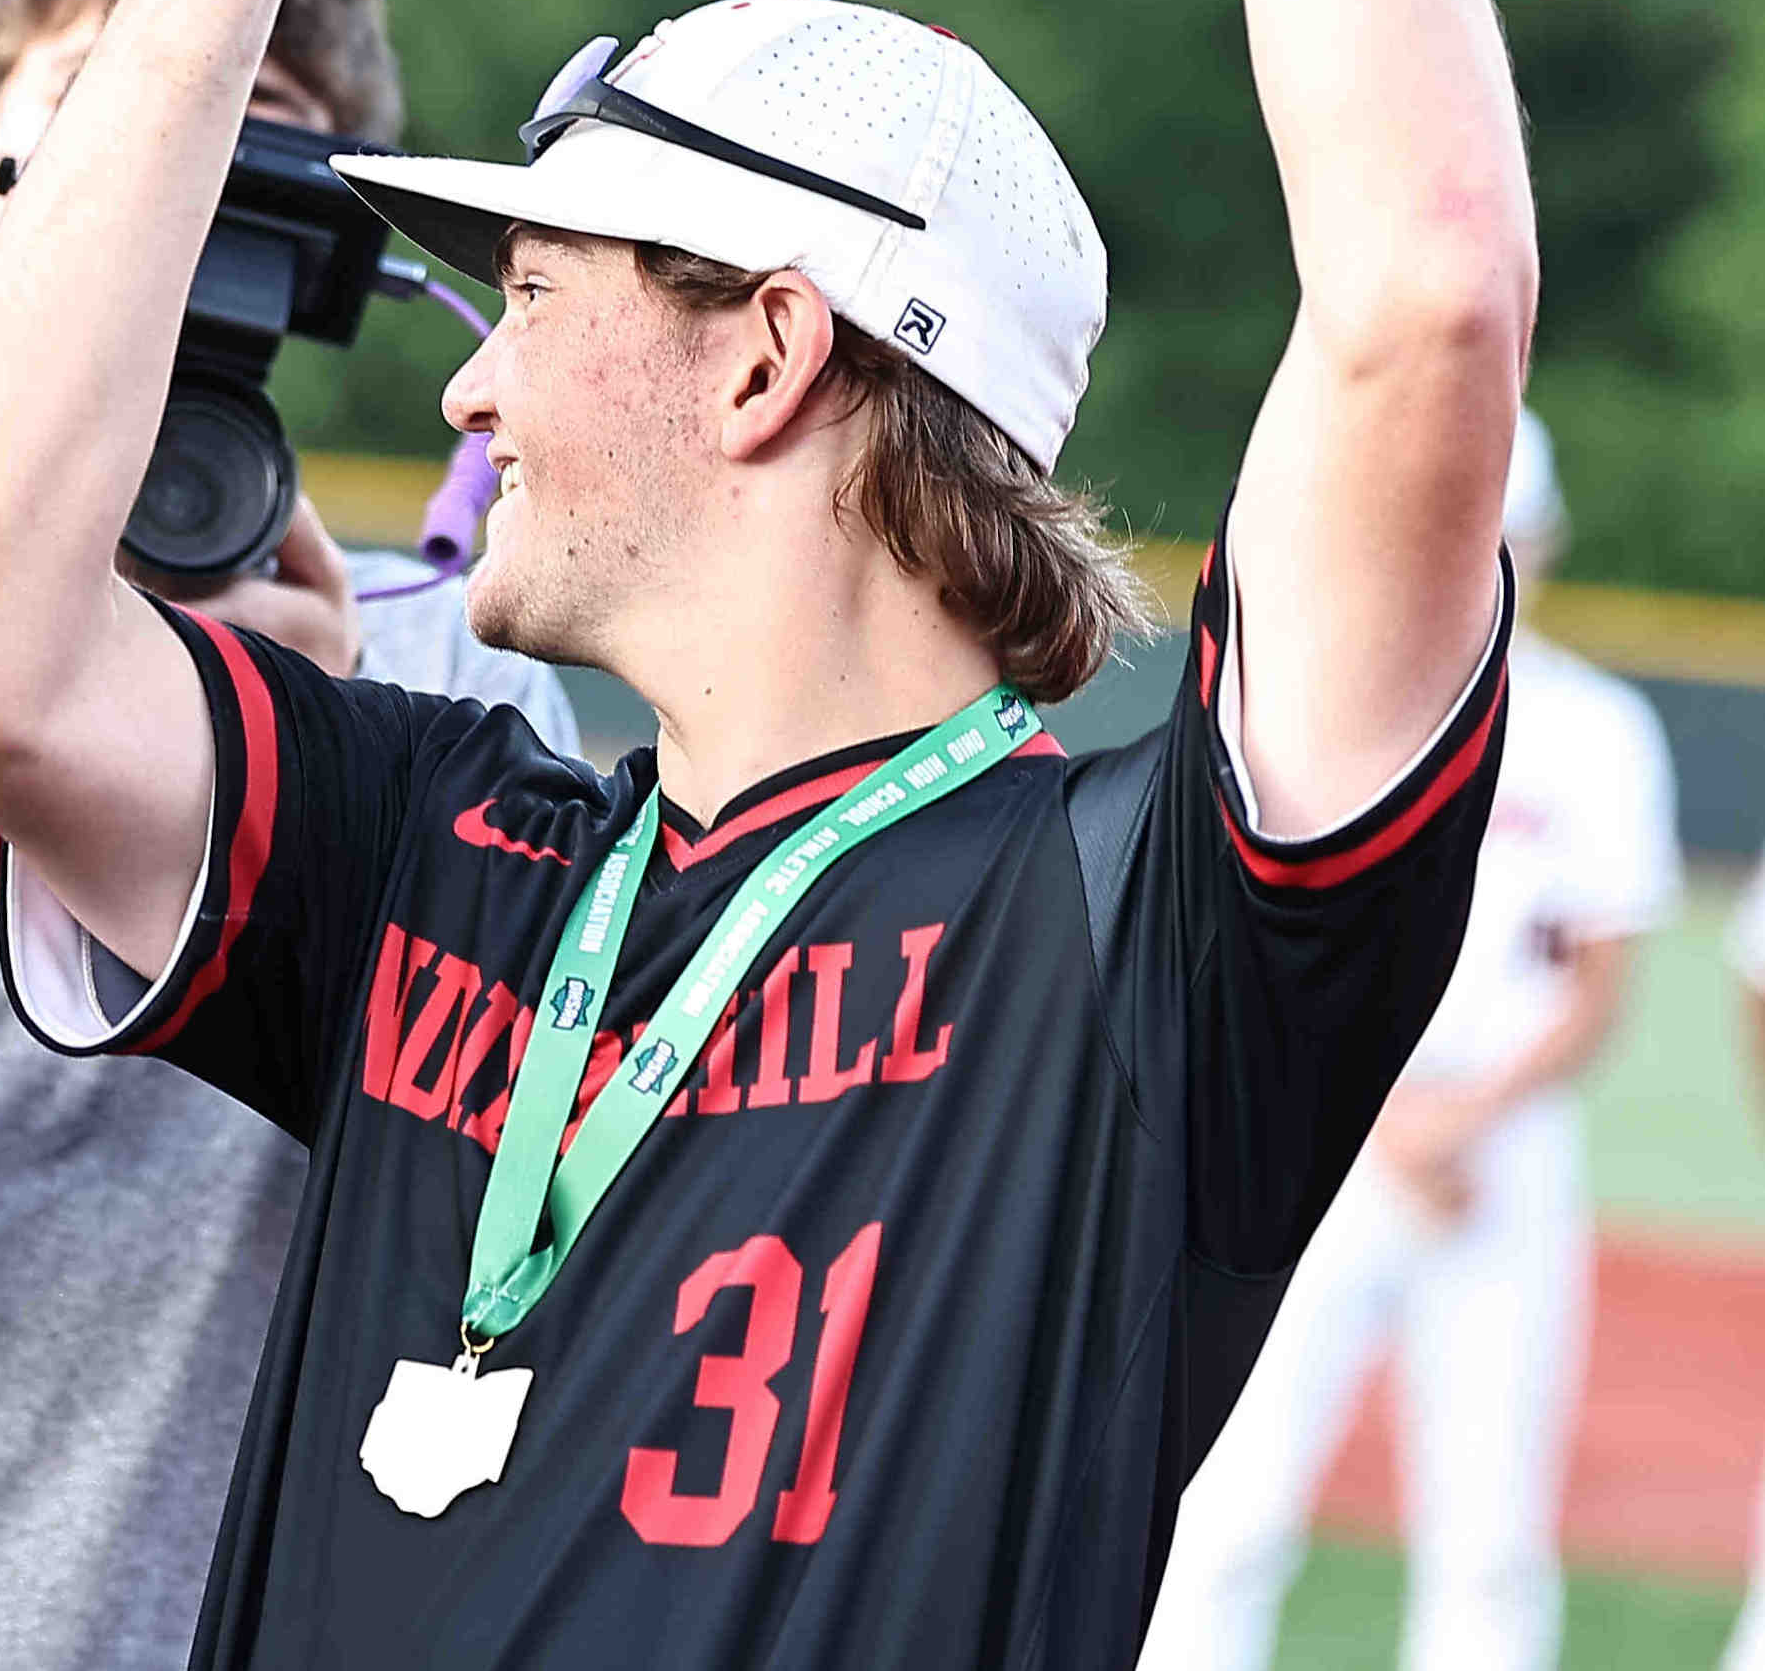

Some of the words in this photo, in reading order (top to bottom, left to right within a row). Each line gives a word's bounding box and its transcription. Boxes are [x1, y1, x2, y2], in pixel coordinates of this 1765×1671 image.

[902, 752, 948, 791] HIGH
[946, 728, 986, 765] OHIO
[838, 782, 907, 827] SCHOOL
[764, 826, 841, 897] ATHLETIC
[578, 852, 631, 954] ASSOCIATION
[620, 1220, 883, 1548] 31
